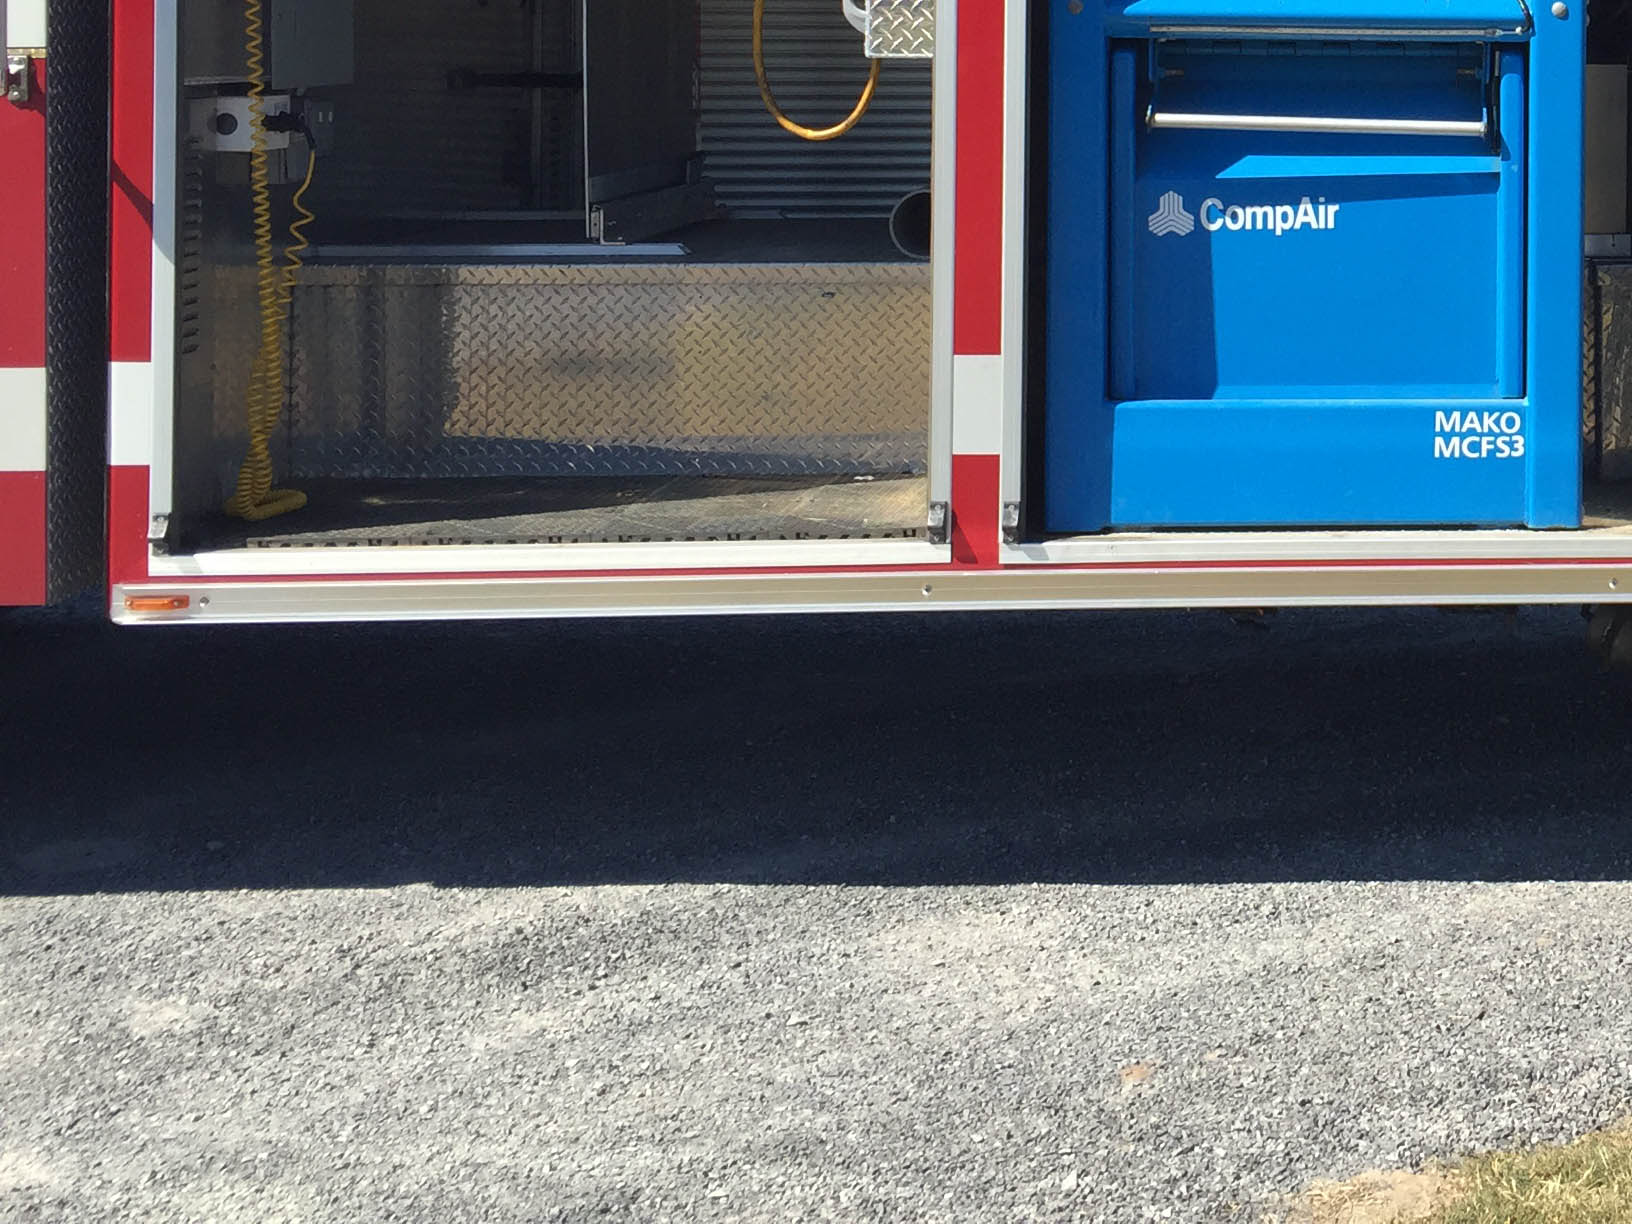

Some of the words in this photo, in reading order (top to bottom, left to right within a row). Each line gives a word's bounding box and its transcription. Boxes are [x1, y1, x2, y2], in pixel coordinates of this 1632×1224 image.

[1200, 197, 1339, 236] CompAir
[1435, 410, 1521, 434] MAKO
[1434, 435, 1525, 459] MCFS3
